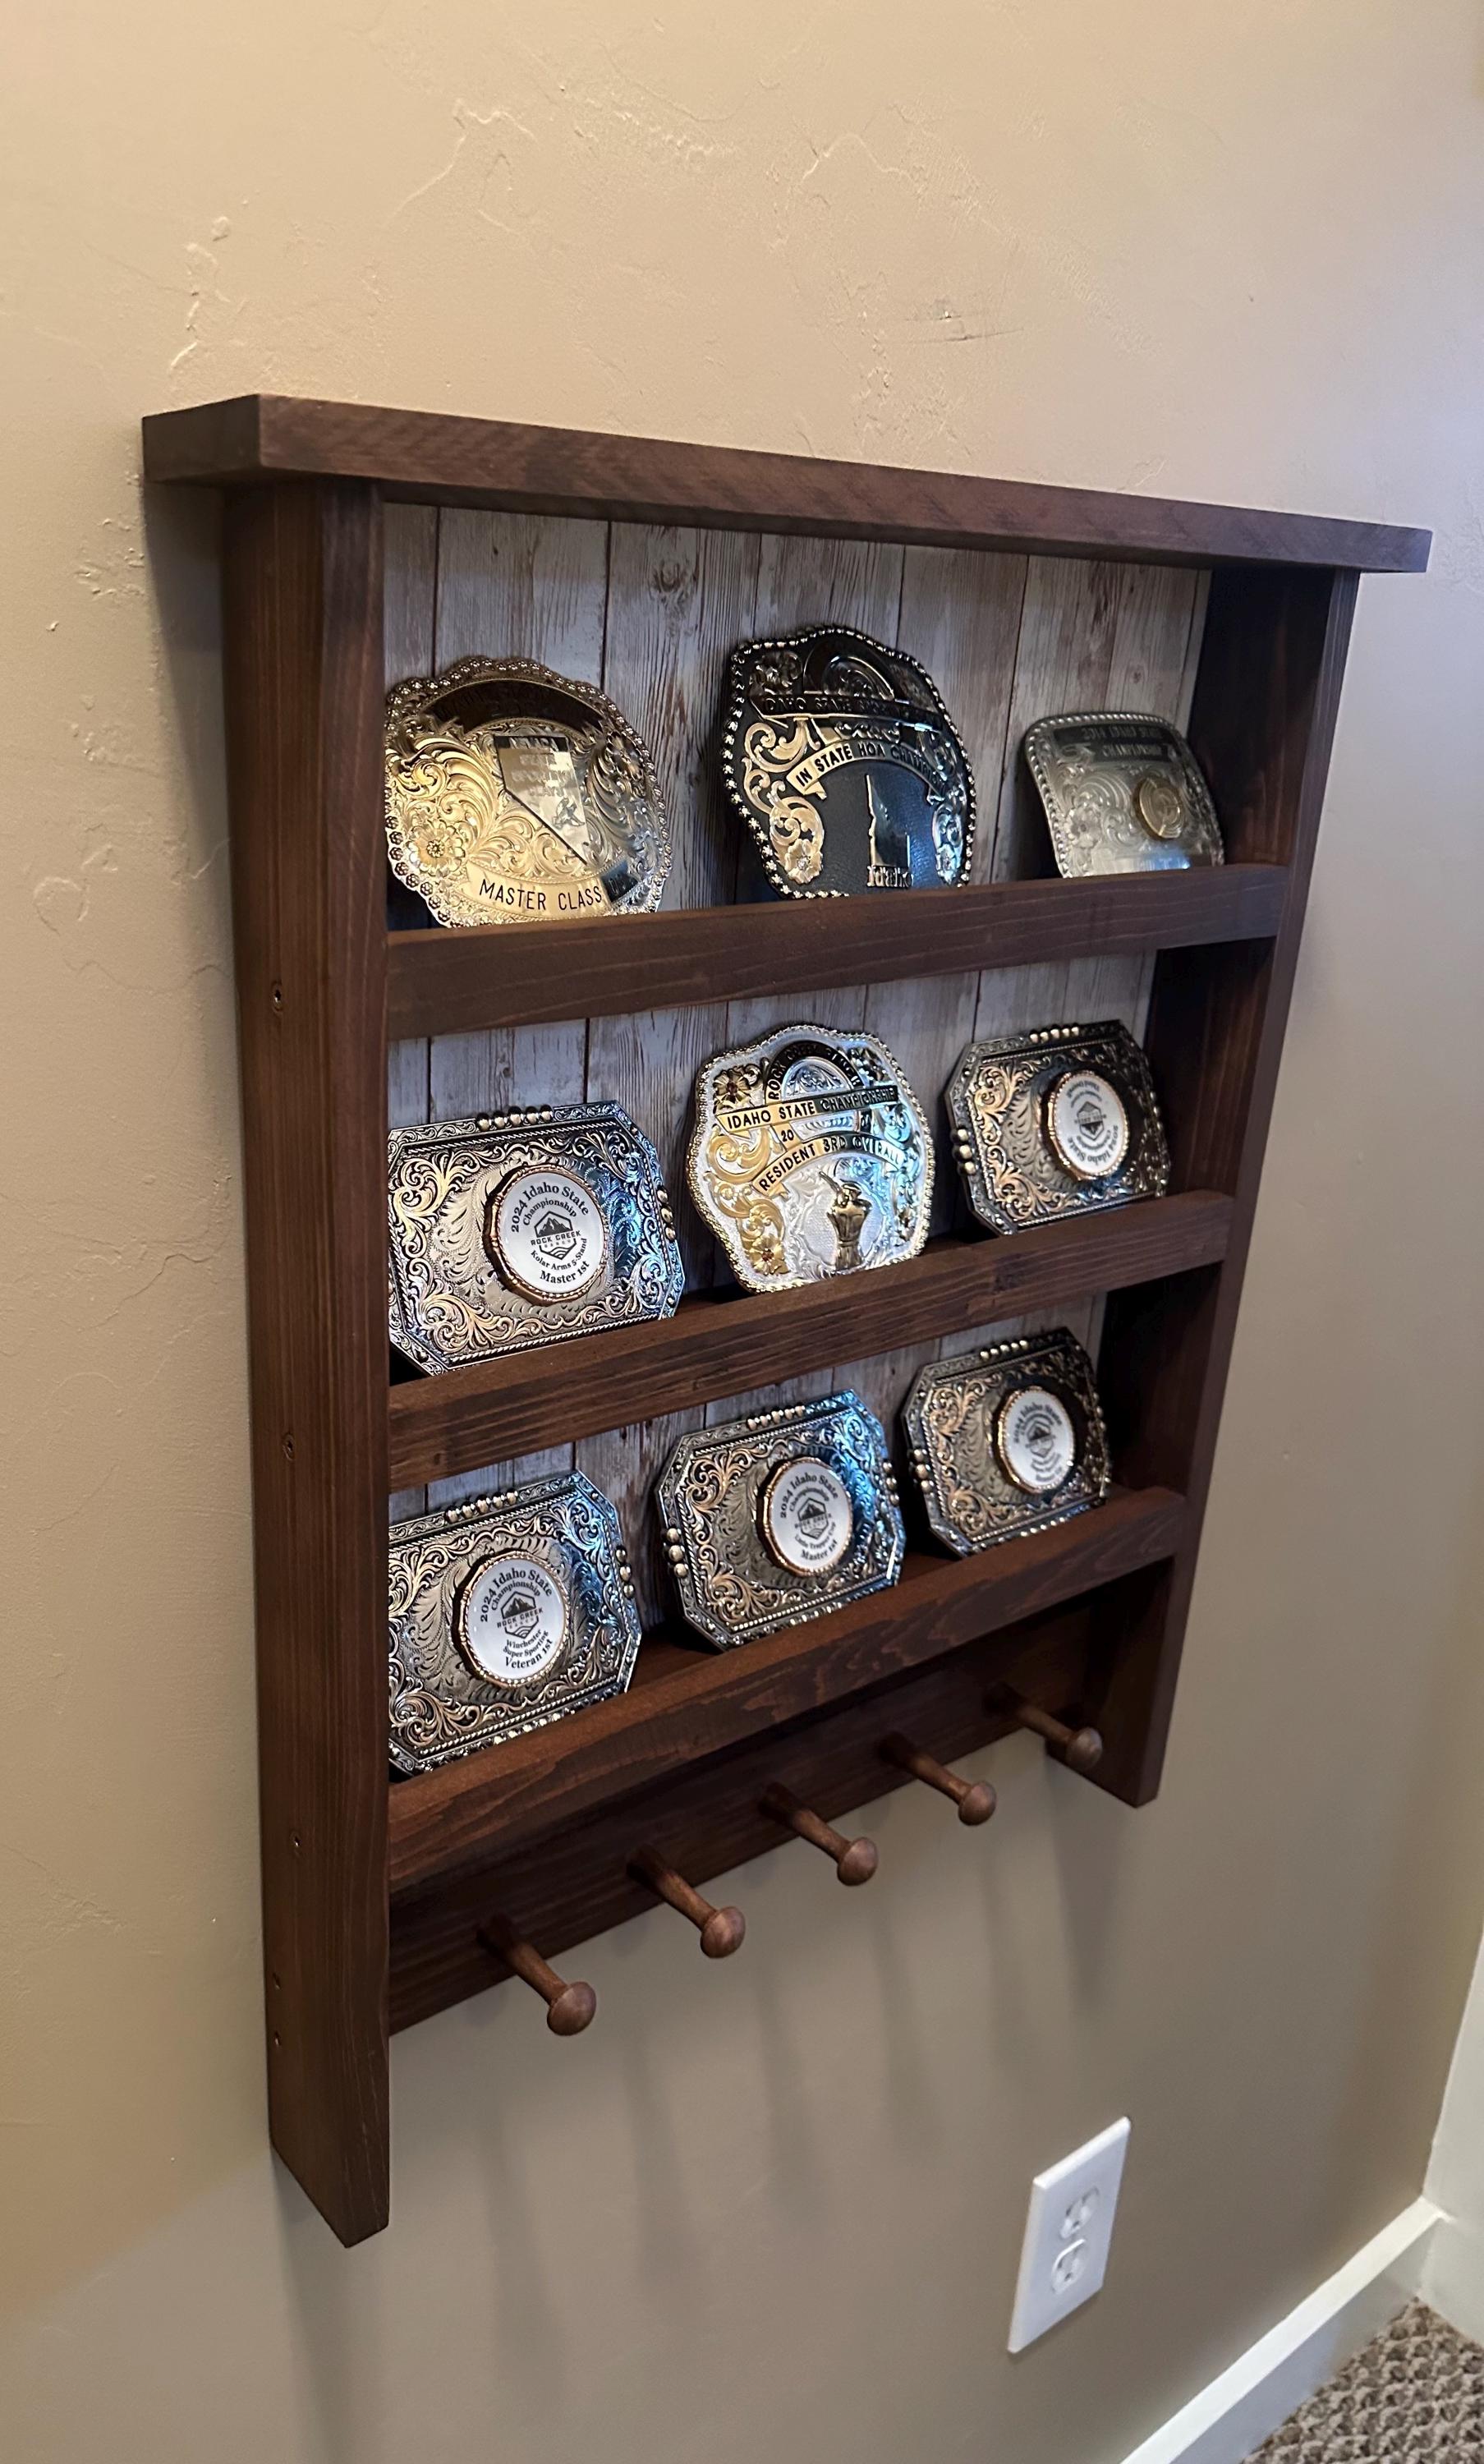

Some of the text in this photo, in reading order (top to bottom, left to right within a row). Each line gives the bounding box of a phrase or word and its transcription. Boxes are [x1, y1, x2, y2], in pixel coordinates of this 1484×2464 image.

[796, 770, 812, 787] IN
[816, 745, 852, 772] STATE
[858, 742, 886, 757] HOA
[479, 879, 547, 911] MASTER
[558, 885, 602, 911] CLASS
[727, 1087, 895, 1129] IDAHO STATE CHAMPIONSHIP
[780, 1129, 794, 1142] 20
[758, 1144, 816, 1192] RESIDENT
[823, 1136, 848, 1153] 3RD
[511, 1182, 590, 1233] 2024 Idaho State
[522, 1198, 577, 1226] Championship
[531, 1230, 582, 1246] ROCK CREEK
[531, 1238, 588, 1271] Kolar Arms 5-Stand
[540, 1260, 590, 1285] Master 1st
[792, 1472, 818, 1490] Idaho
[819, 1474, 838, 1499] State
[801, 1549, 828, 1561] Master
[480, 1567, 553, 1623] 2024 Idaho State
[491, 1580, 540, 1611] Championship
[496, 1607, 544, 1629] ROCK CREEK
[503, 1630, 549, 1658] Super Sporting
[506, 1629, 543, 1648] Winchester
[505, 1639, 554, 1670] Veteran 1st
